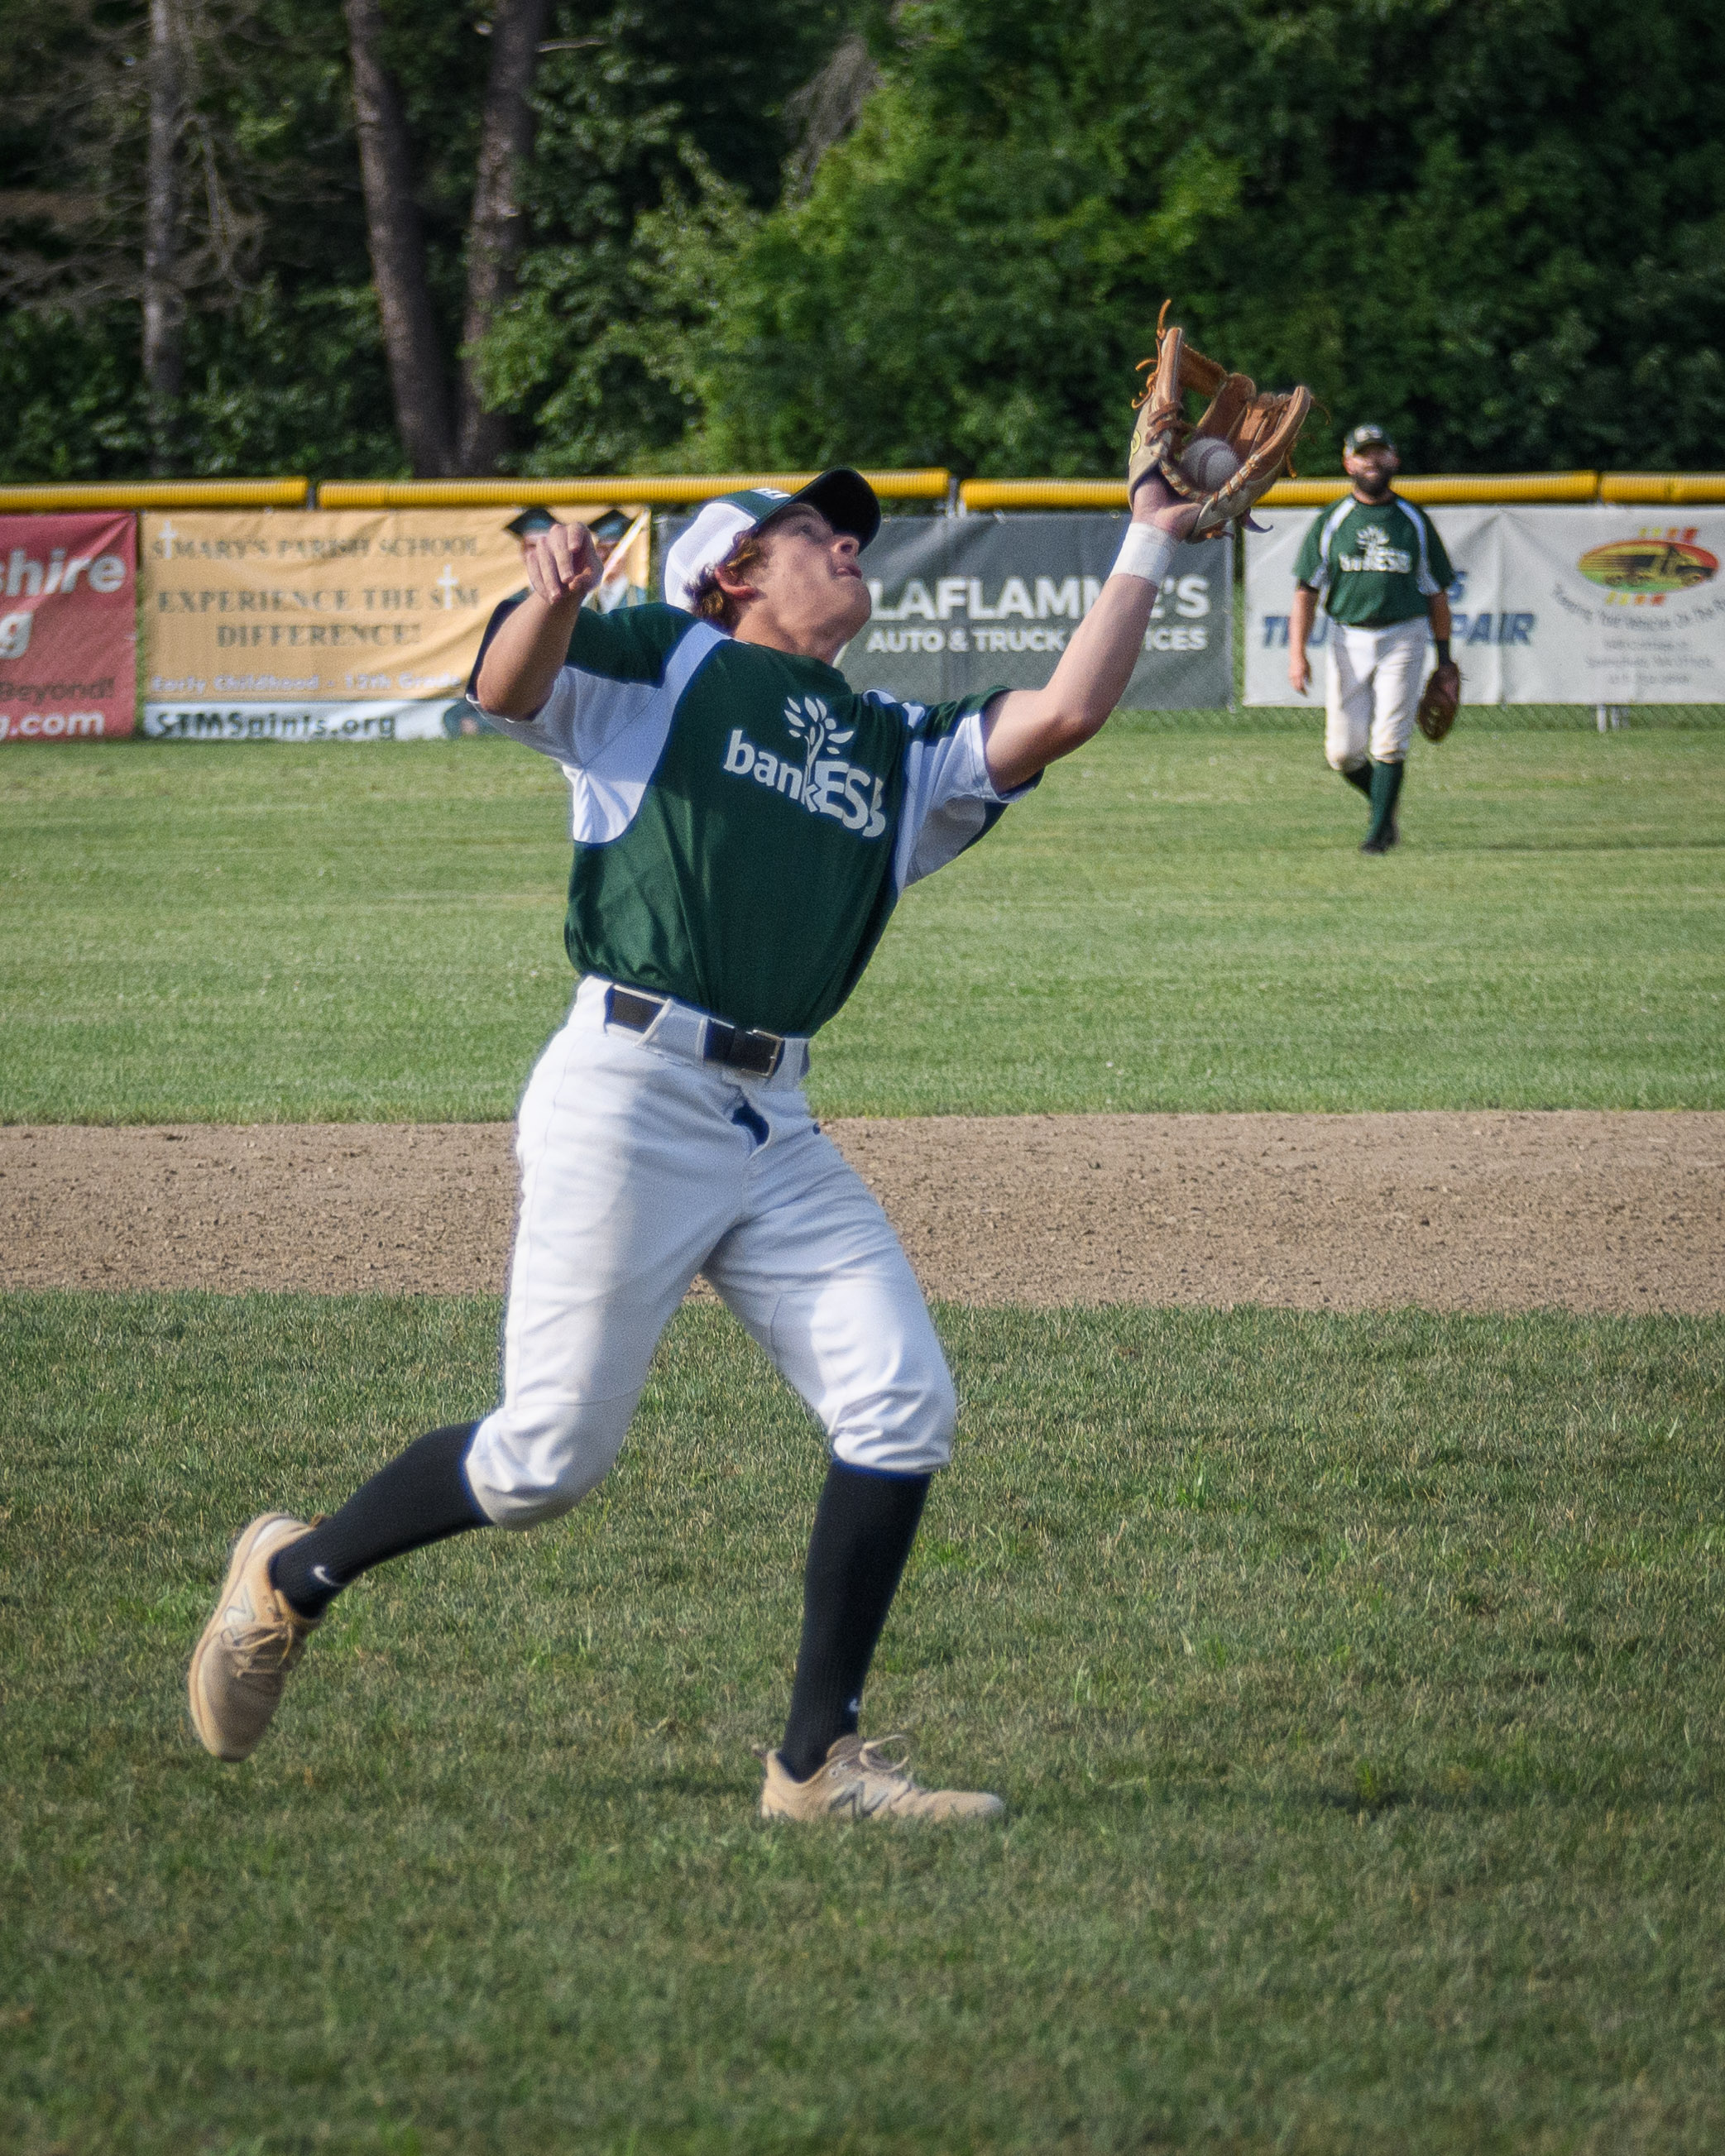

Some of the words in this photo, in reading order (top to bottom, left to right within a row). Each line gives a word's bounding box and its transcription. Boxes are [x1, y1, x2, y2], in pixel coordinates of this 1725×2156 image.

[0, 547, 126, 597] hire
[158, 589, 352, 614] EXPERIENCE
[362, 588, 419, 611] THE
[866, 627, 943, 653] AUTO
[948, 627, 970, 653] &
[974, 626, 1066, 652] TRUCK
[1450, 612, 1536, 646] PAIR
[156, 711, 395, 740] STMSaints.org
